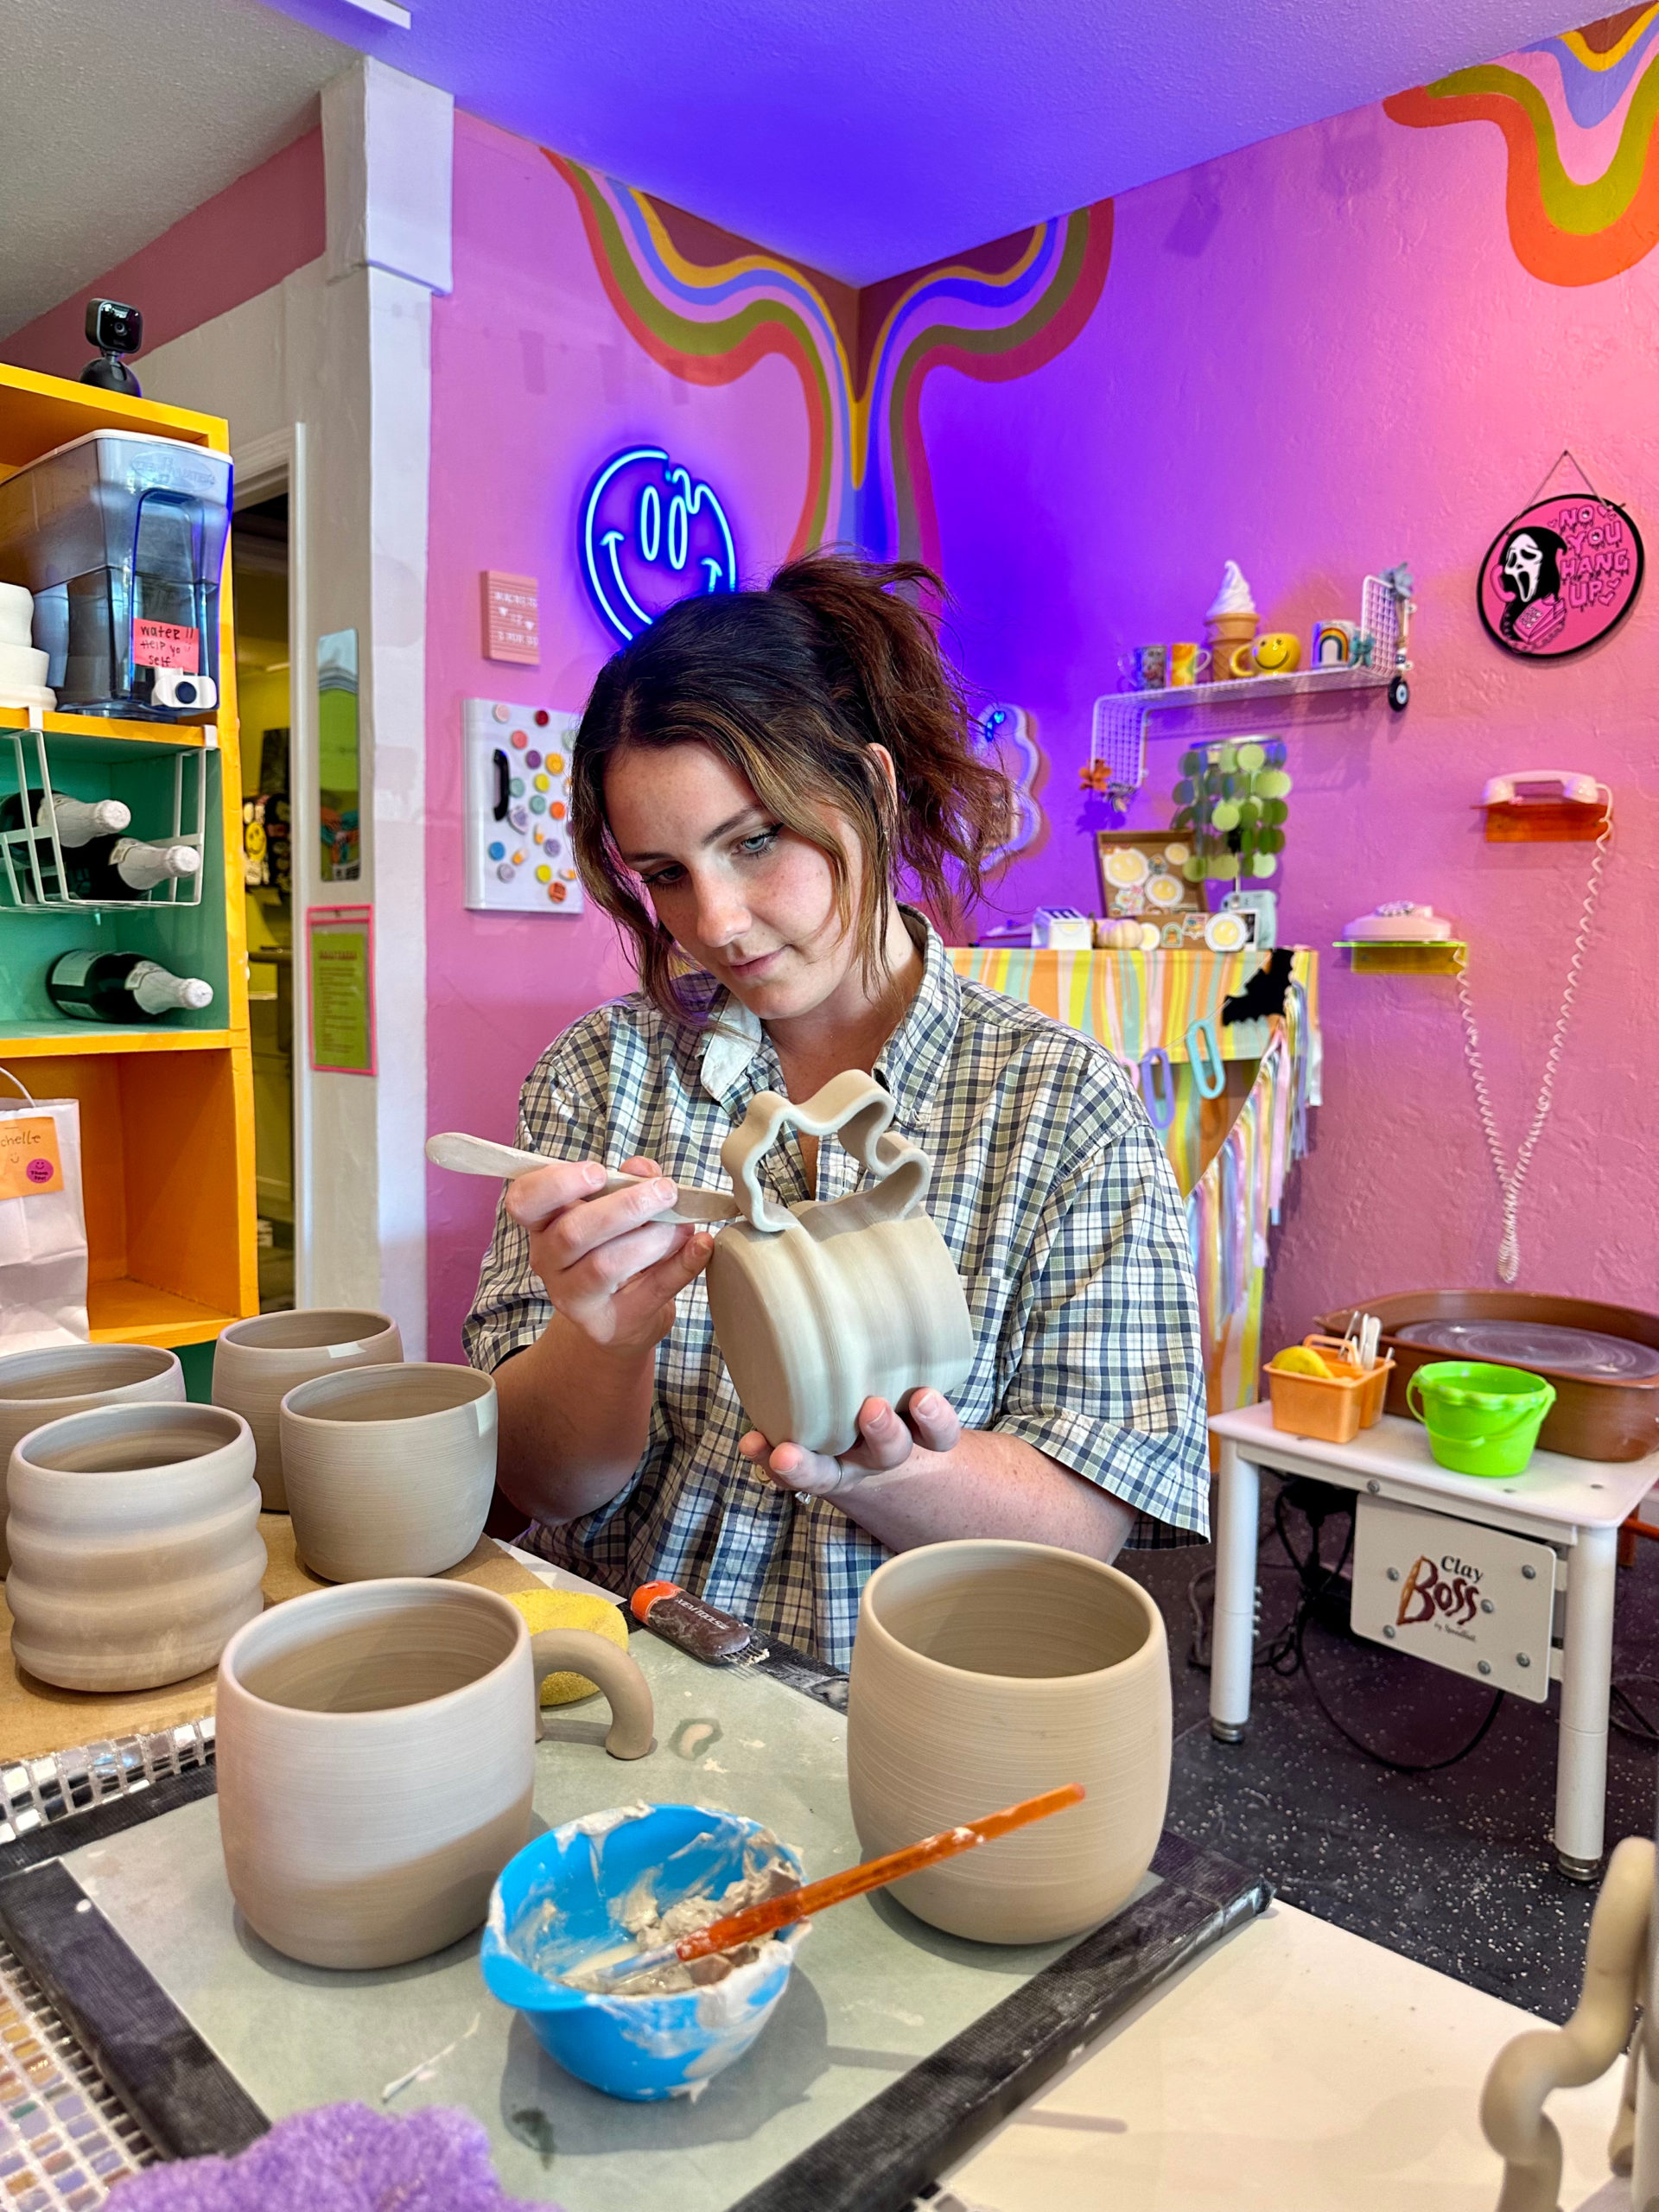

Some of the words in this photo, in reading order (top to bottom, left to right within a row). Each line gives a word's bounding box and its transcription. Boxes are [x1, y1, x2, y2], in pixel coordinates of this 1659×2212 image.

[1558, 505, 1595, 530] NO
[1567, 520, 1623, 555] YOU
[1559, 549, 1630, 580] HANG
[1568, 580, 1604, 609] UP
[1440, 1554, 1484, 1583] Clay
